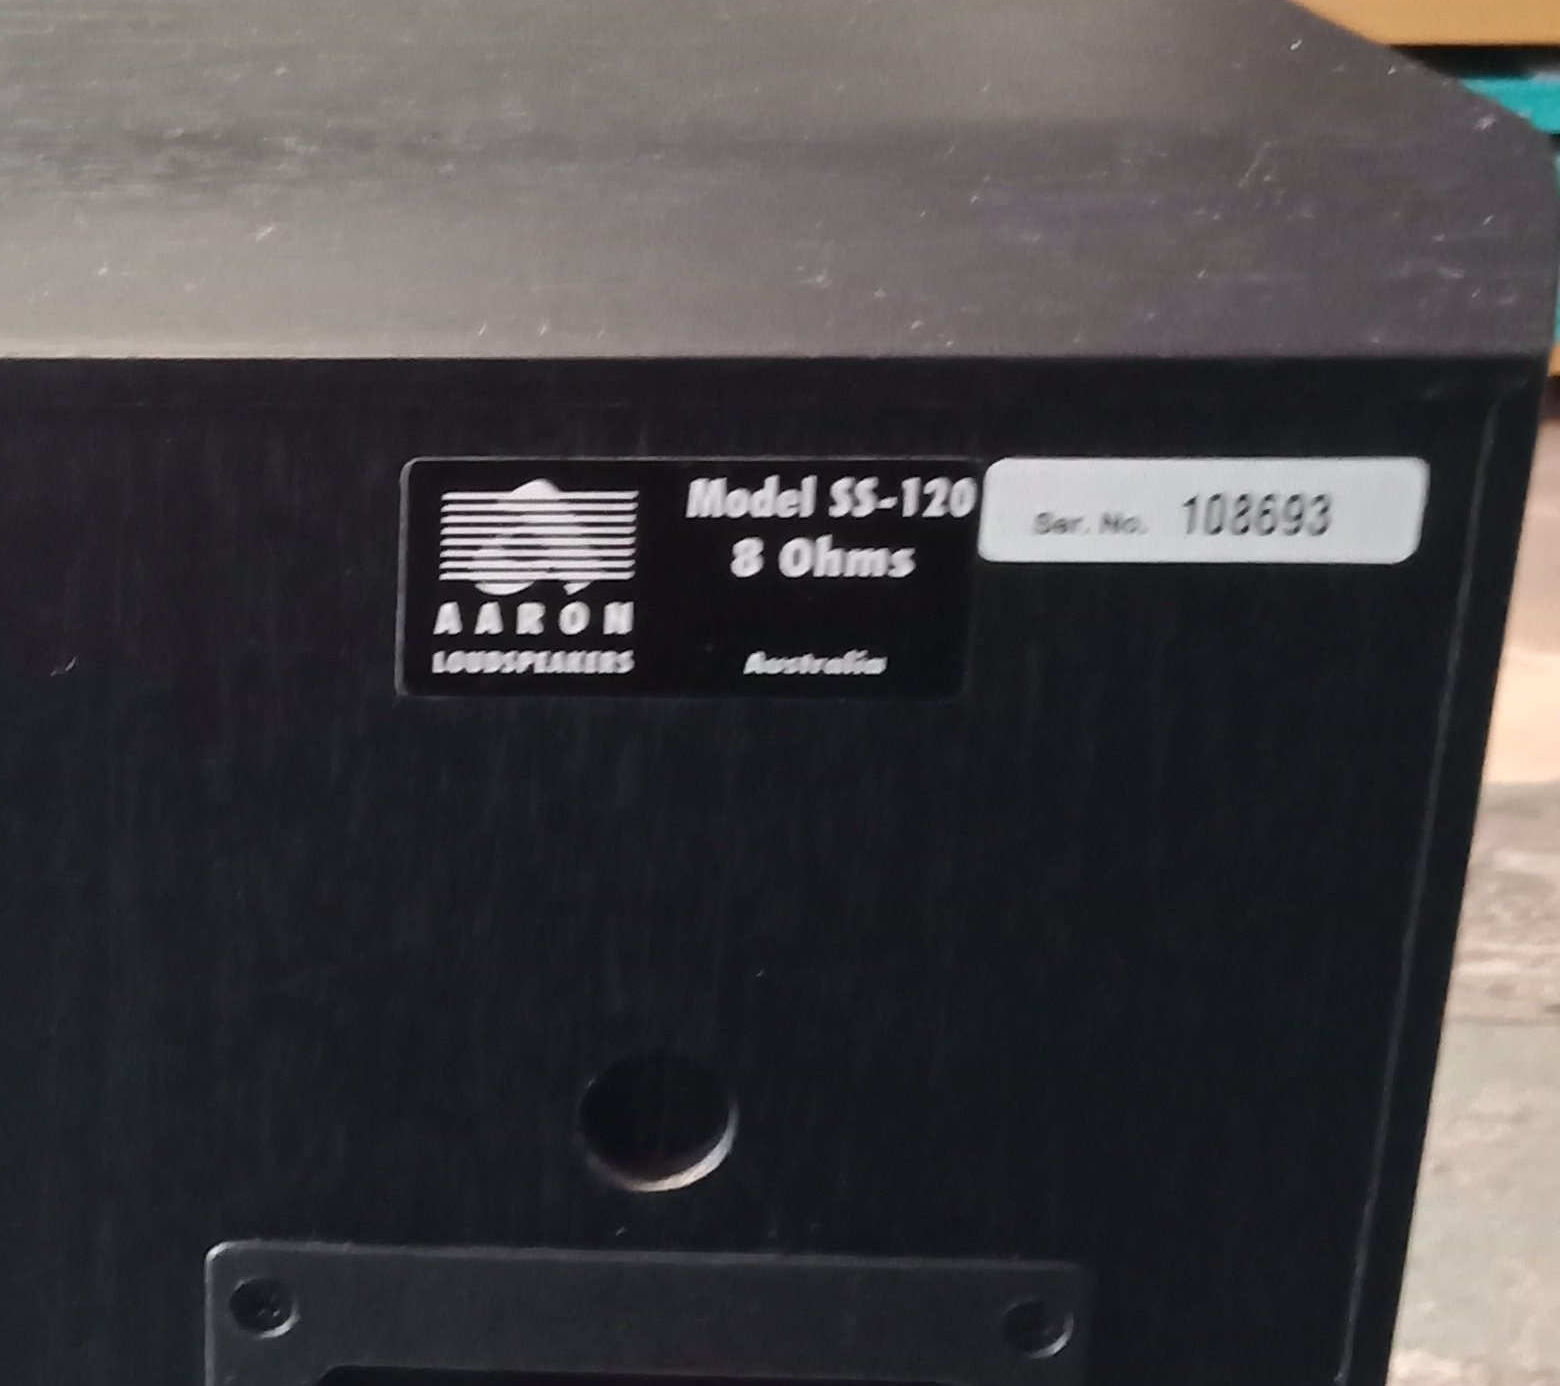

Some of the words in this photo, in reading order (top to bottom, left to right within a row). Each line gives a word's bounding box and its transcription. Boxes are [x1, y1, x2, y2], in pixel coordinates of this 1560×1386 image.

[686, 474, 818, 518] Model
[828, 476, 978, 518] SS-120
[1098, 511, 1148, 536] No.
[1182, 492, 1335, 537] 108693
[730, 537, 765, 578] 8
[778, 534, 917, 578] Ohms
[432, 601, 635, 635] AARON
[432, 649, 636, 674] LOUDSPEAKERS
[743, 649, 888, 675] Australia
